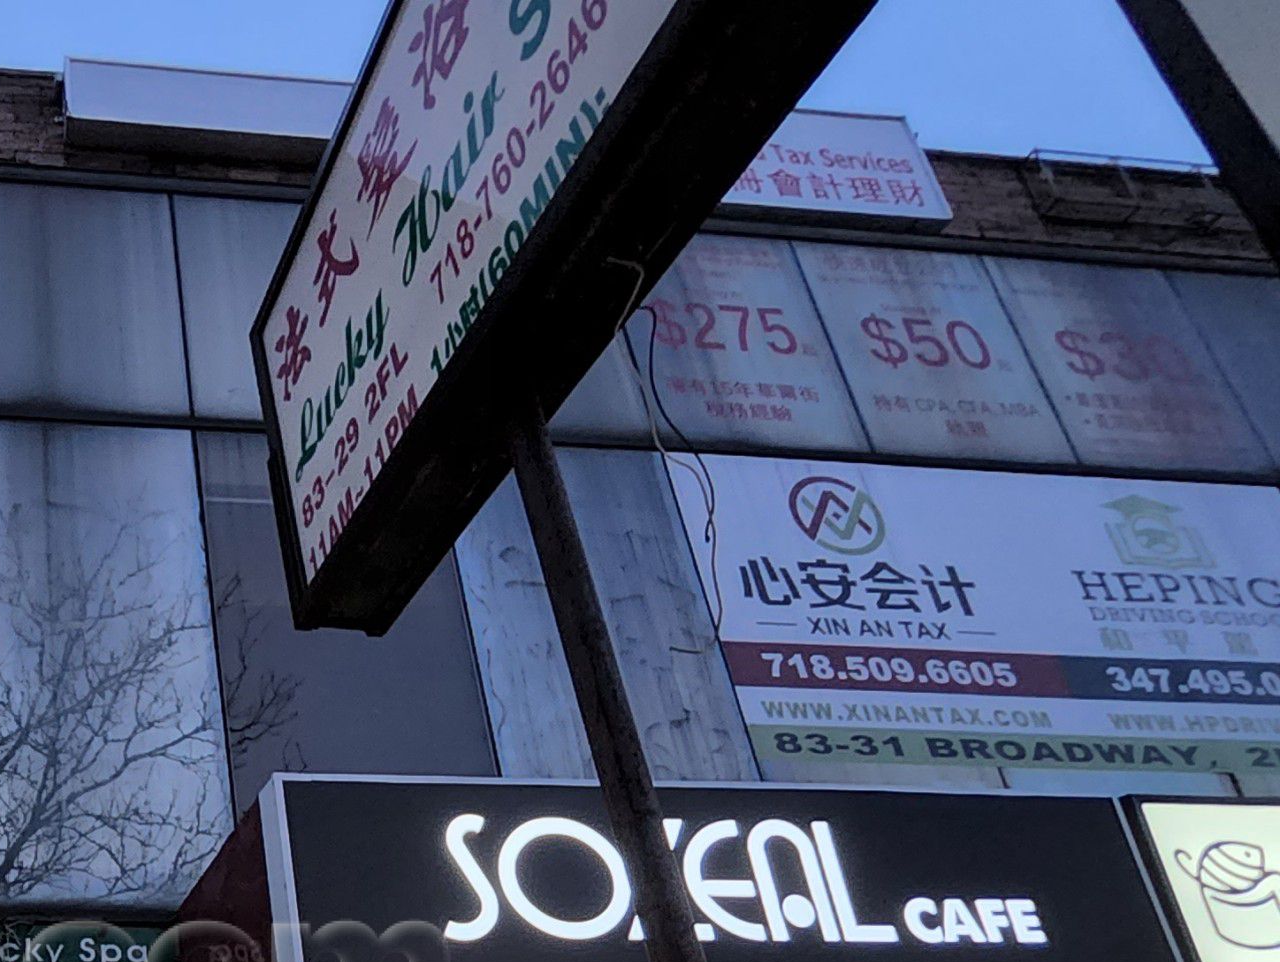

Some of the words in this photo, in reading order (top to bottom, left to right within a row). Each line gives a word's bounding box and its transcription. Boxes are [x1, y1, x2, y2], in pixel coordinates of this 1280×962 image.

[769, 144, 814, 166] Tax
[819, 148, 914, 174] Services
[295, 286, 390, 483] Lucky
[392, 70, 506, 287] Hair
[301, 416, 360, 528] 83-29
[364, 342, 409, 424] 2FL
[429, 0, 608, 304] 718-760-2646
[654, 302, 798, 357] $275
[860, 312, 992, 370] $50
[739, 556, 976, 616] 心安会计
[1071, 570, 1280, 608] HEPING
[806, 617, 850, 636] XIN
[859, 620, 894, 638] AN
[898, 621, 952, 640] TAX
[761, 652, 1017, 689] 718.509.6605
[761, 700, 1052, 729] WWW.XINANTAX.COM
[774, 732, 906, 758] 83-31
[924, 736, 1218, 770] BROADWAY,
[444, 814, 898, 943] SOEAL
[904, 897, 1047, 945] CAFE
